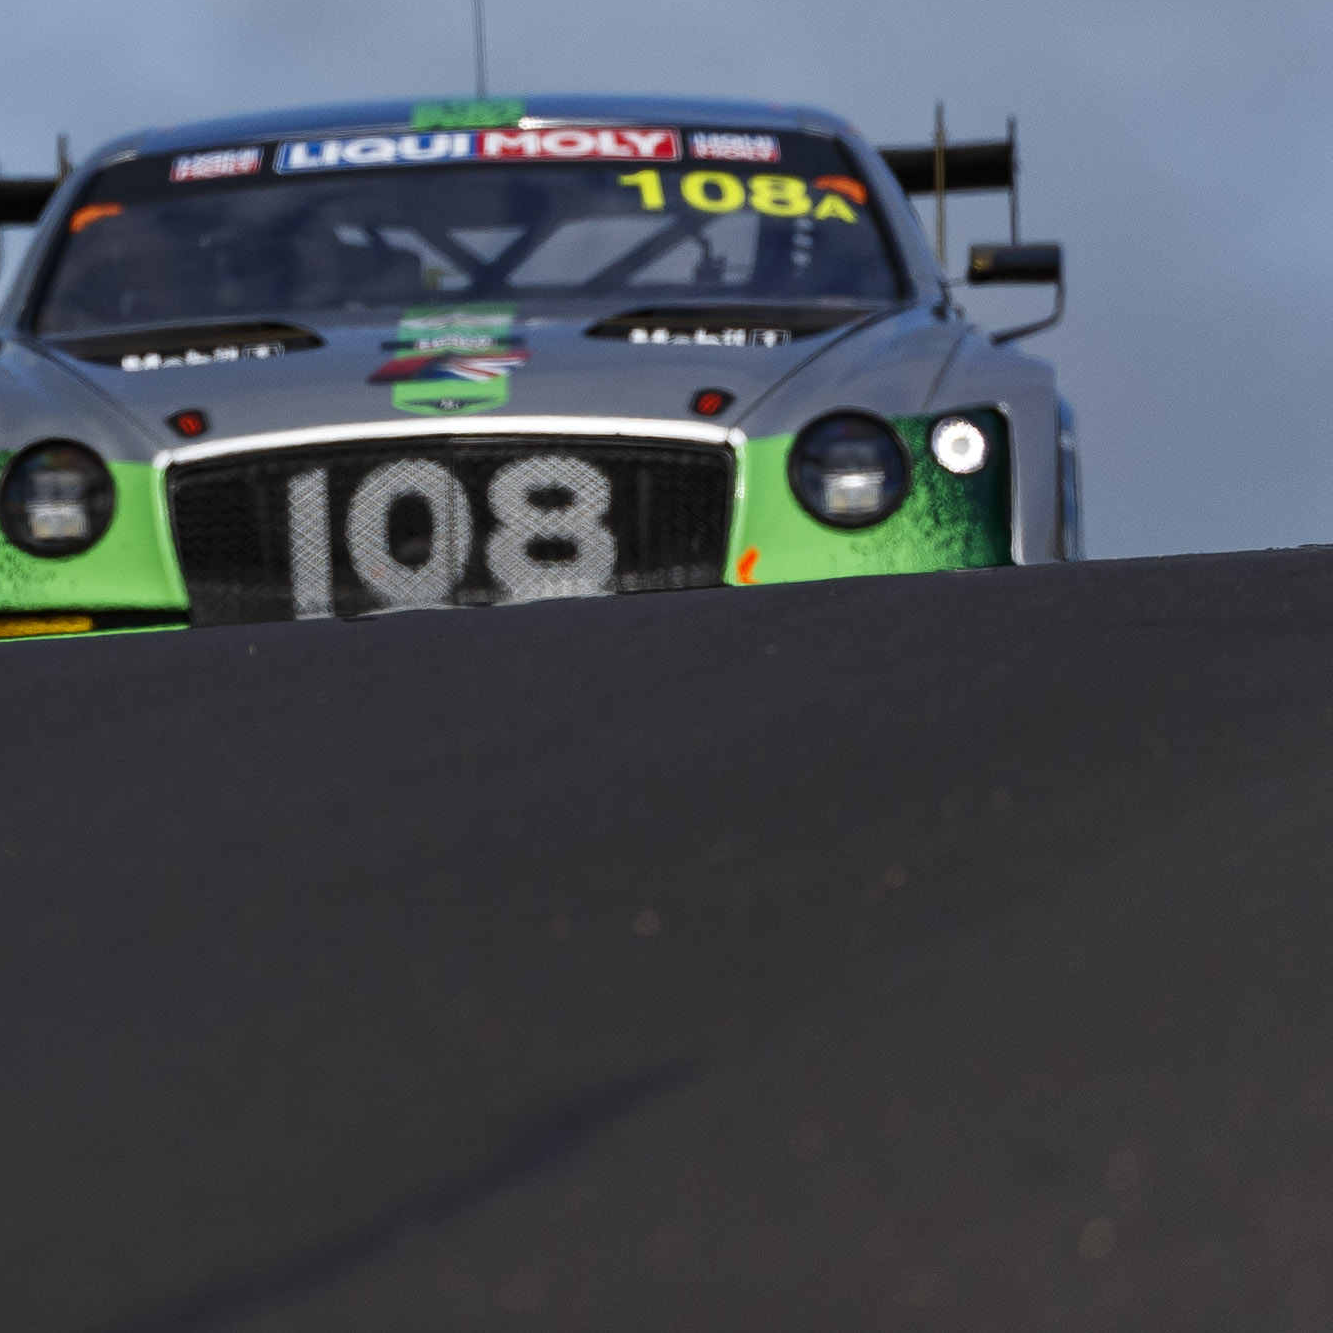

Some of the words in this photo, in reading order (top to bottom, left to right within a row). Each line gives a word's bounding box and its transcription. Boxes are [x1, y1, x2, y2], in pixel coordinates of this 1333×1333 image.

[287, 132, 472, 171] LIQUI
[483, 129, 669, 160] MOLY
[288, 457, 618, 621] 108
